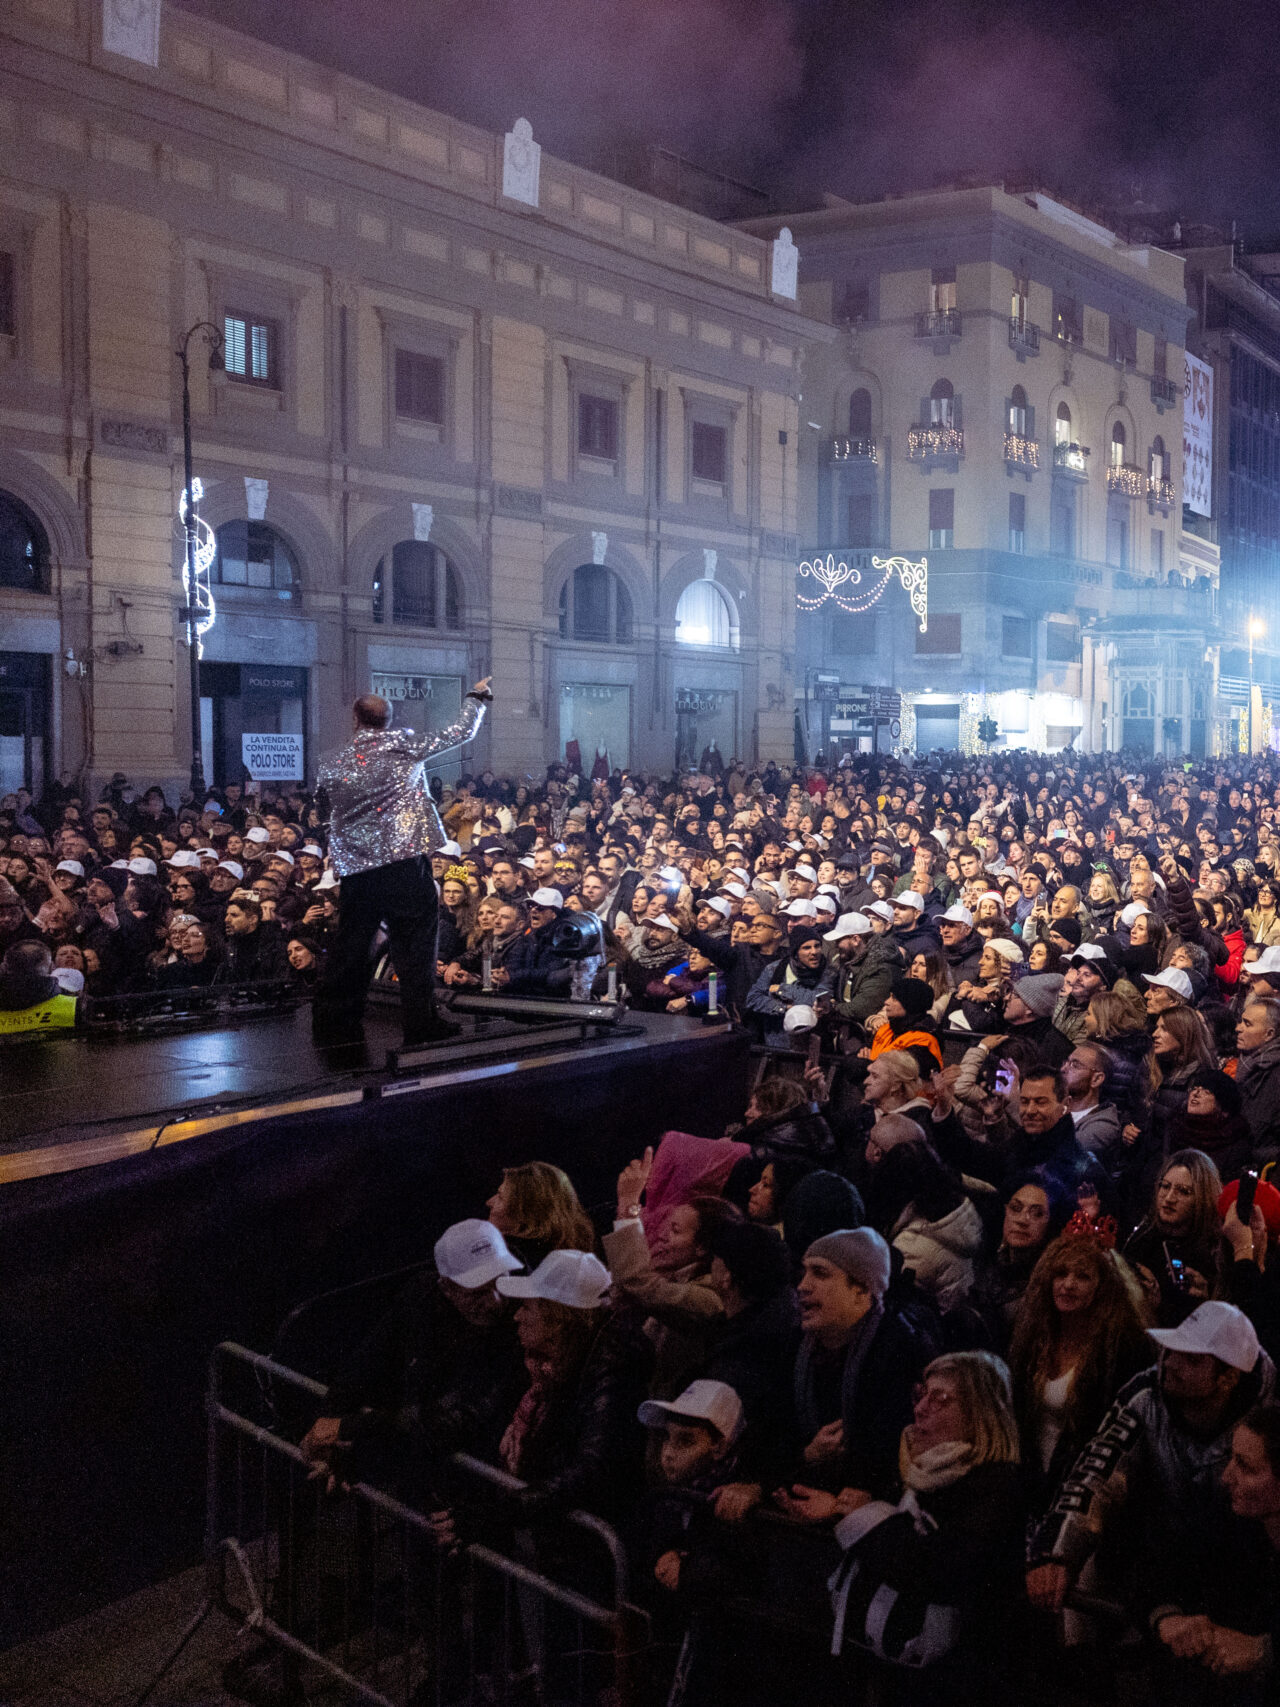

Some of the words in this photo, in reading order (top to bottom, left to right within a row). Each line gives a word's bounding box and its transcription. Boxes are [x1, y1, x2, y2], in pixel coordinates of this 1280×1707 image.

[249, 678, 271, 687] POLO
[271, 679, 295, 688] STORE
[376, 686, 434, 699] motivi
[250, 736, 260, 744] LA
[262, 736, 295, 744] VENDITA
[245, 744, 288, 752] CONTINUA
[288, 744, 300, 752] DA
[250, 754, 271, 768] POLO
[272, 754, 296, 768] STORE
